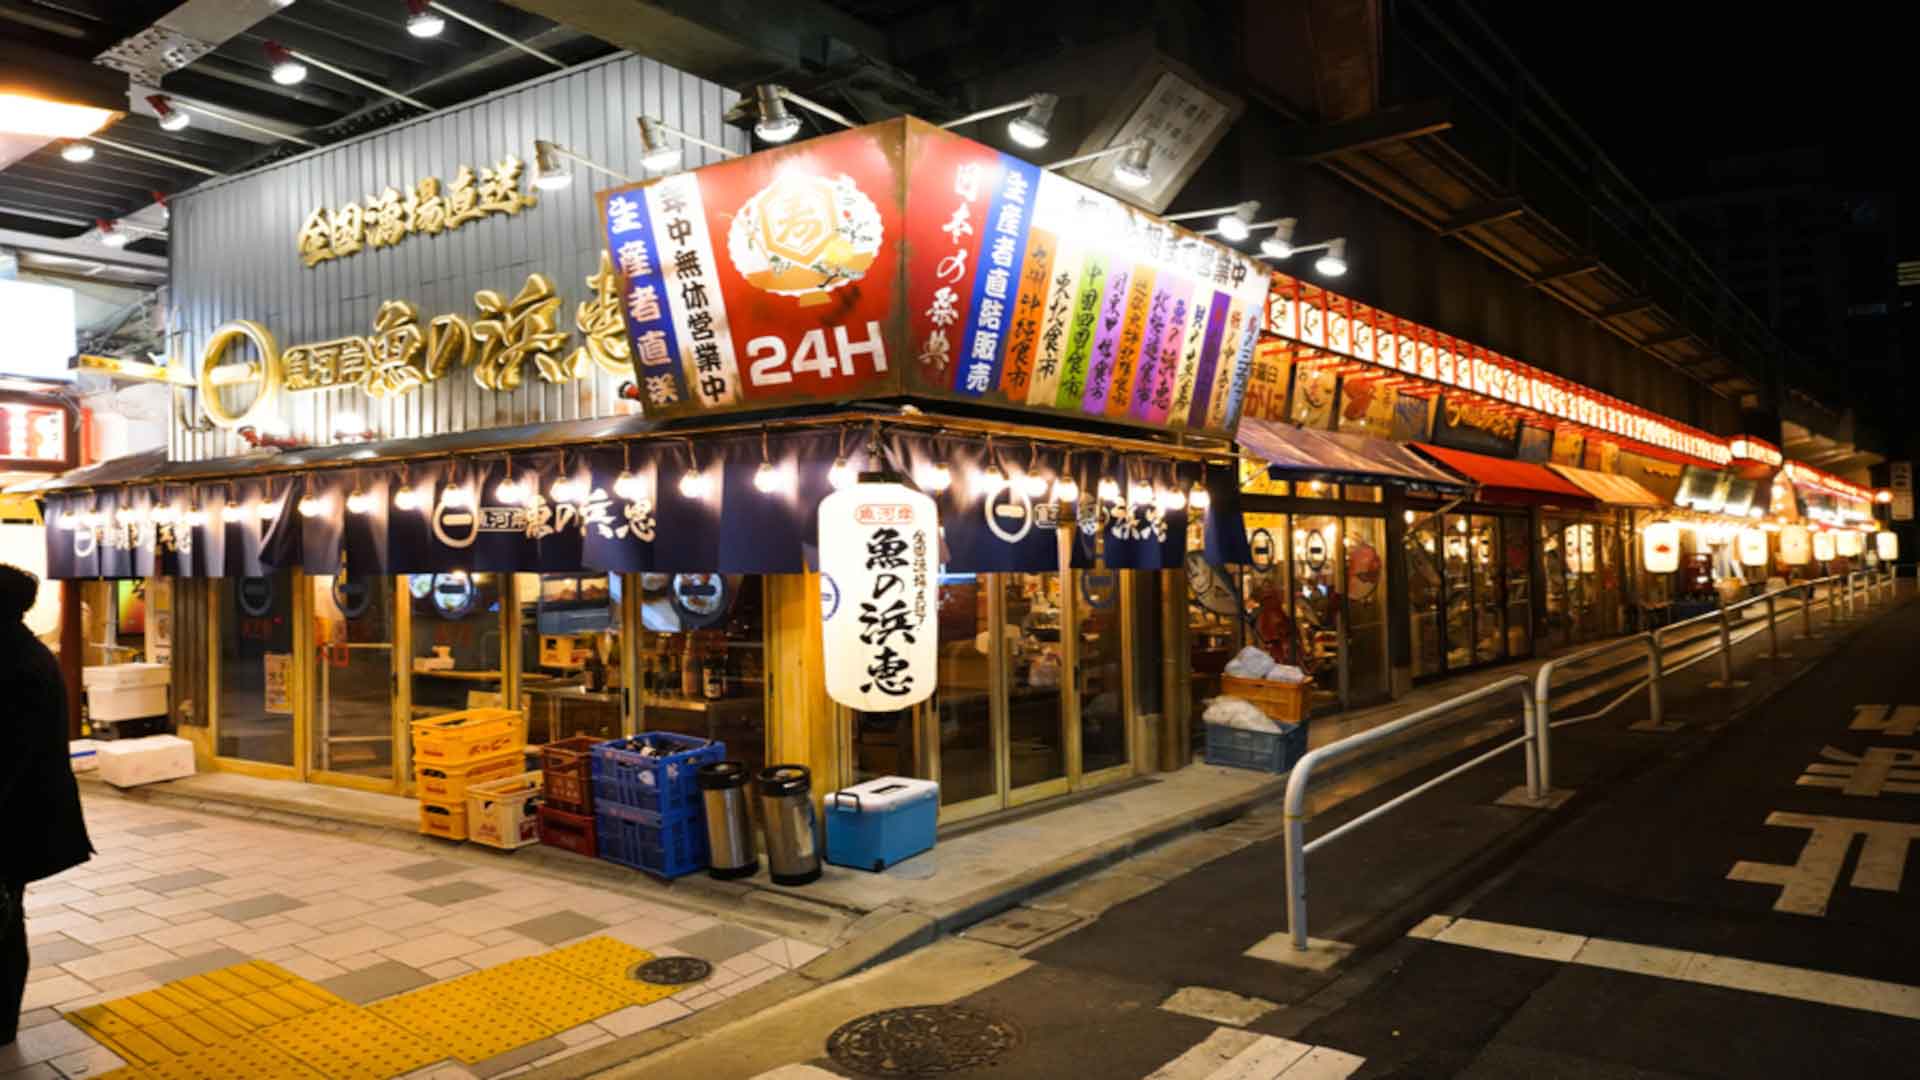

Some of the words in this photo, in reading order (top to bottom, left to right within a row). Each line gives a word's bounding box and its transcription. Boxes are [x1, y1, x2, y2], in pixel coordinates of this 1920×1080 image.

[299, 153, 538, 268] 全国漁場直送
[661, 182, 726, 403] 年中無休営業中
[918, 162, 980, 372] 日本の祭典
[747, 322, 889, 387] 24H
[858, 527, 916, 696] 魚の浜恵
